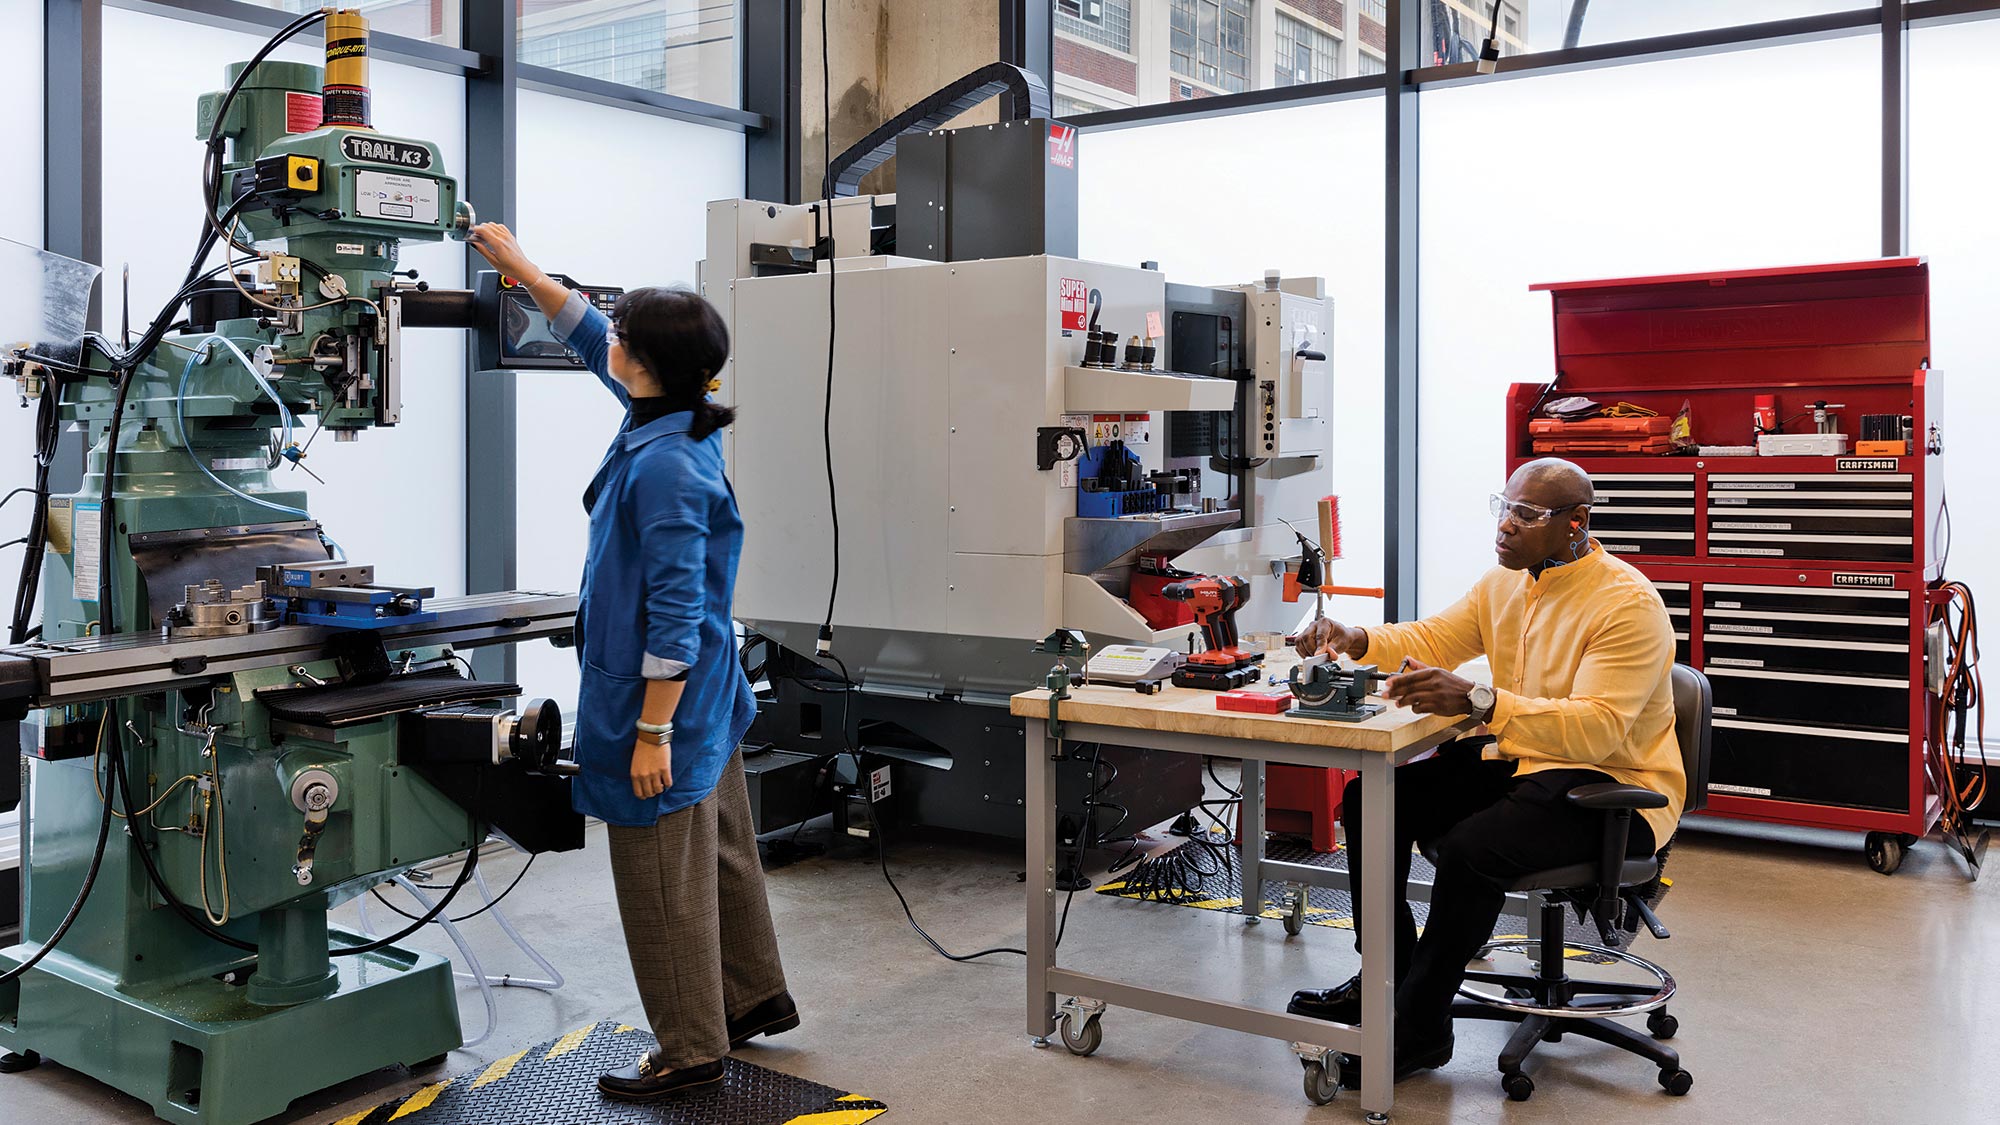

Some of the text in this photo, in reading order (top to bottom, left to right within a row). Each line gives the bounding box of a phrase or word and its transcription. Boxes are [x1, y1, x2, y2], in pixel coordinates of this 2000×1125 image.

[401, 150, 421, 165] K3
[1050, 153, 1074, 167] HAAS
[1060, 279, 1085, 299] SUPER
[1840, 461, 1894, 469] CRAFTSMAN
[1836, 576, 1891, 585] CRAFTSMAN
